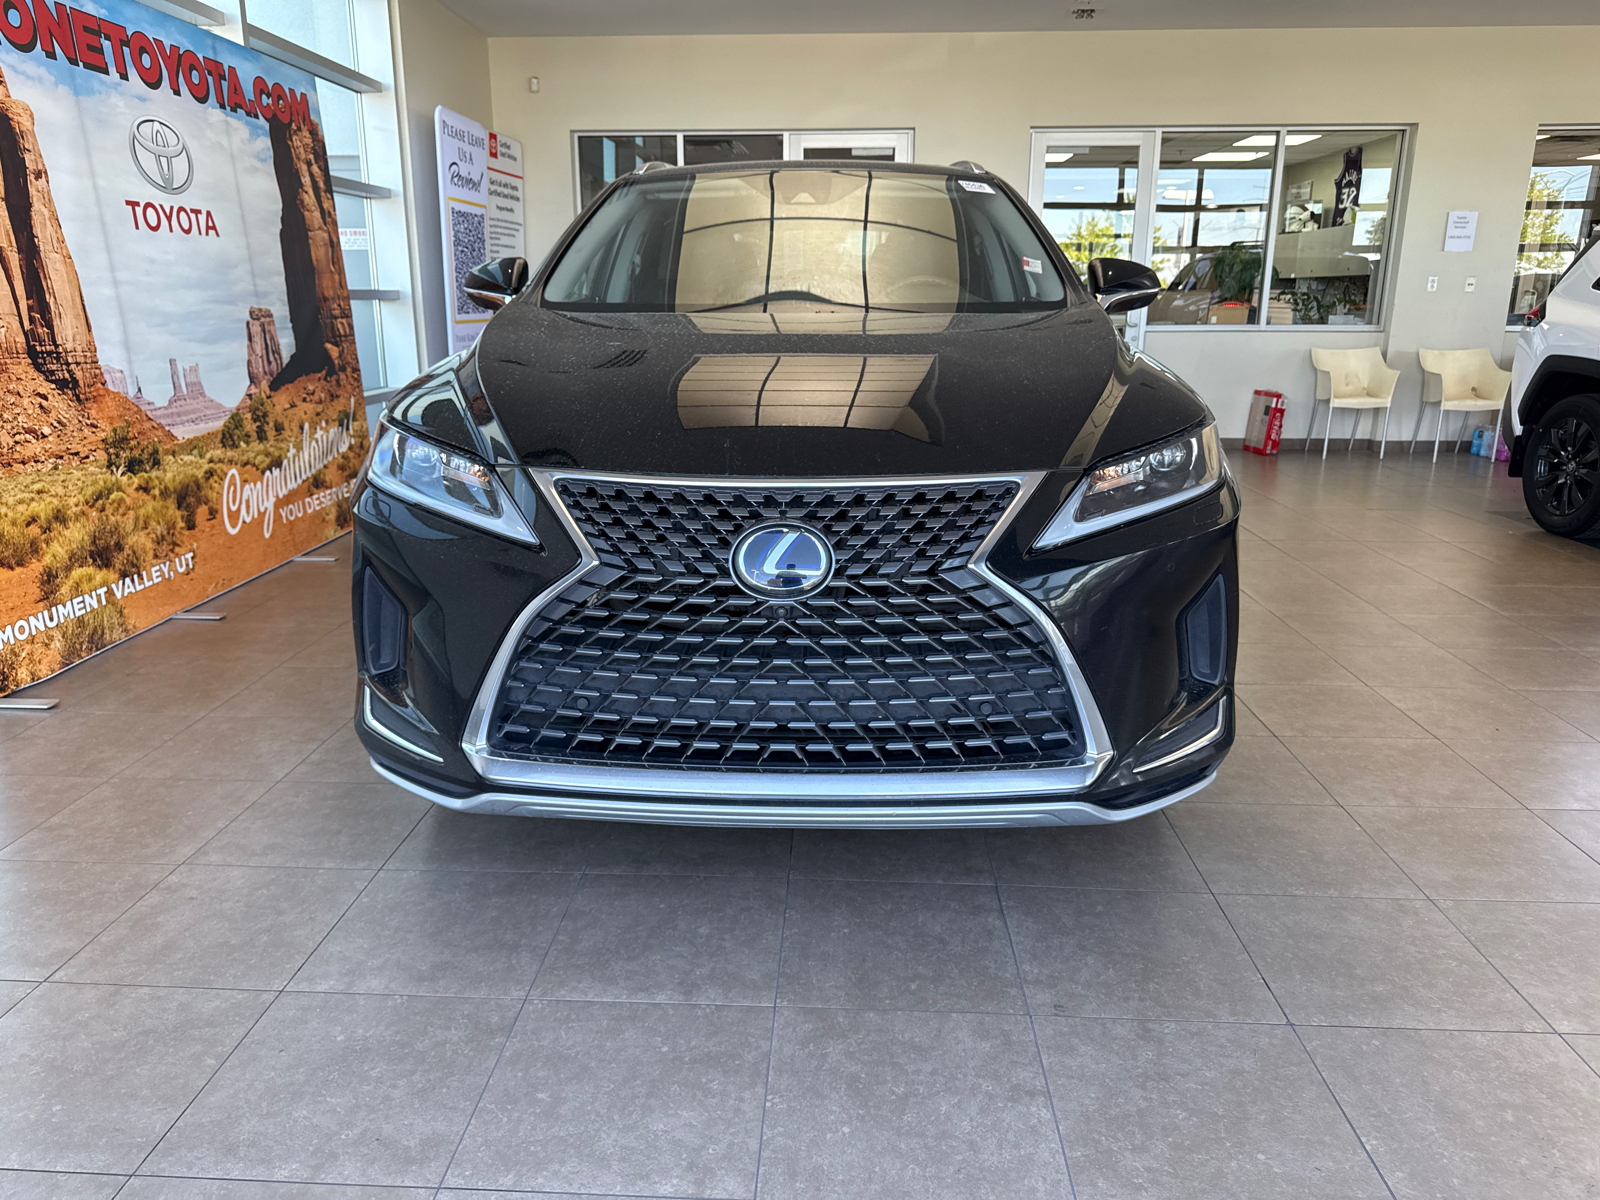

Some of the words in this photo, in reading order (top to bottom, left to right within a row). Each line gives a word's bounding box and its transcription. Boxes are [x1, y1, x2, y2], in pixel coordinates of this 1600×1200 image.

[442, 119, 466, 143] PLEASE
[467, 130, 486, 151] LEAVE
[457, 146, 467, 164] US
[468, 151, 475, 166] A
[448, 161, 484, 193] Review!
[1338, 187, 1357, 209] 32
[125, 199, 220, 238] TOYOTA
[223, 396, 355, 538] Congratulations!
[279, 501, 304, 523] YOU
[304, 482, 350, 514] DESERVE
[0, 587, 107, 649] MONUMENT
[111, 562, 174, 601] VALLEY,
[175, 551, 195, 578] UT
